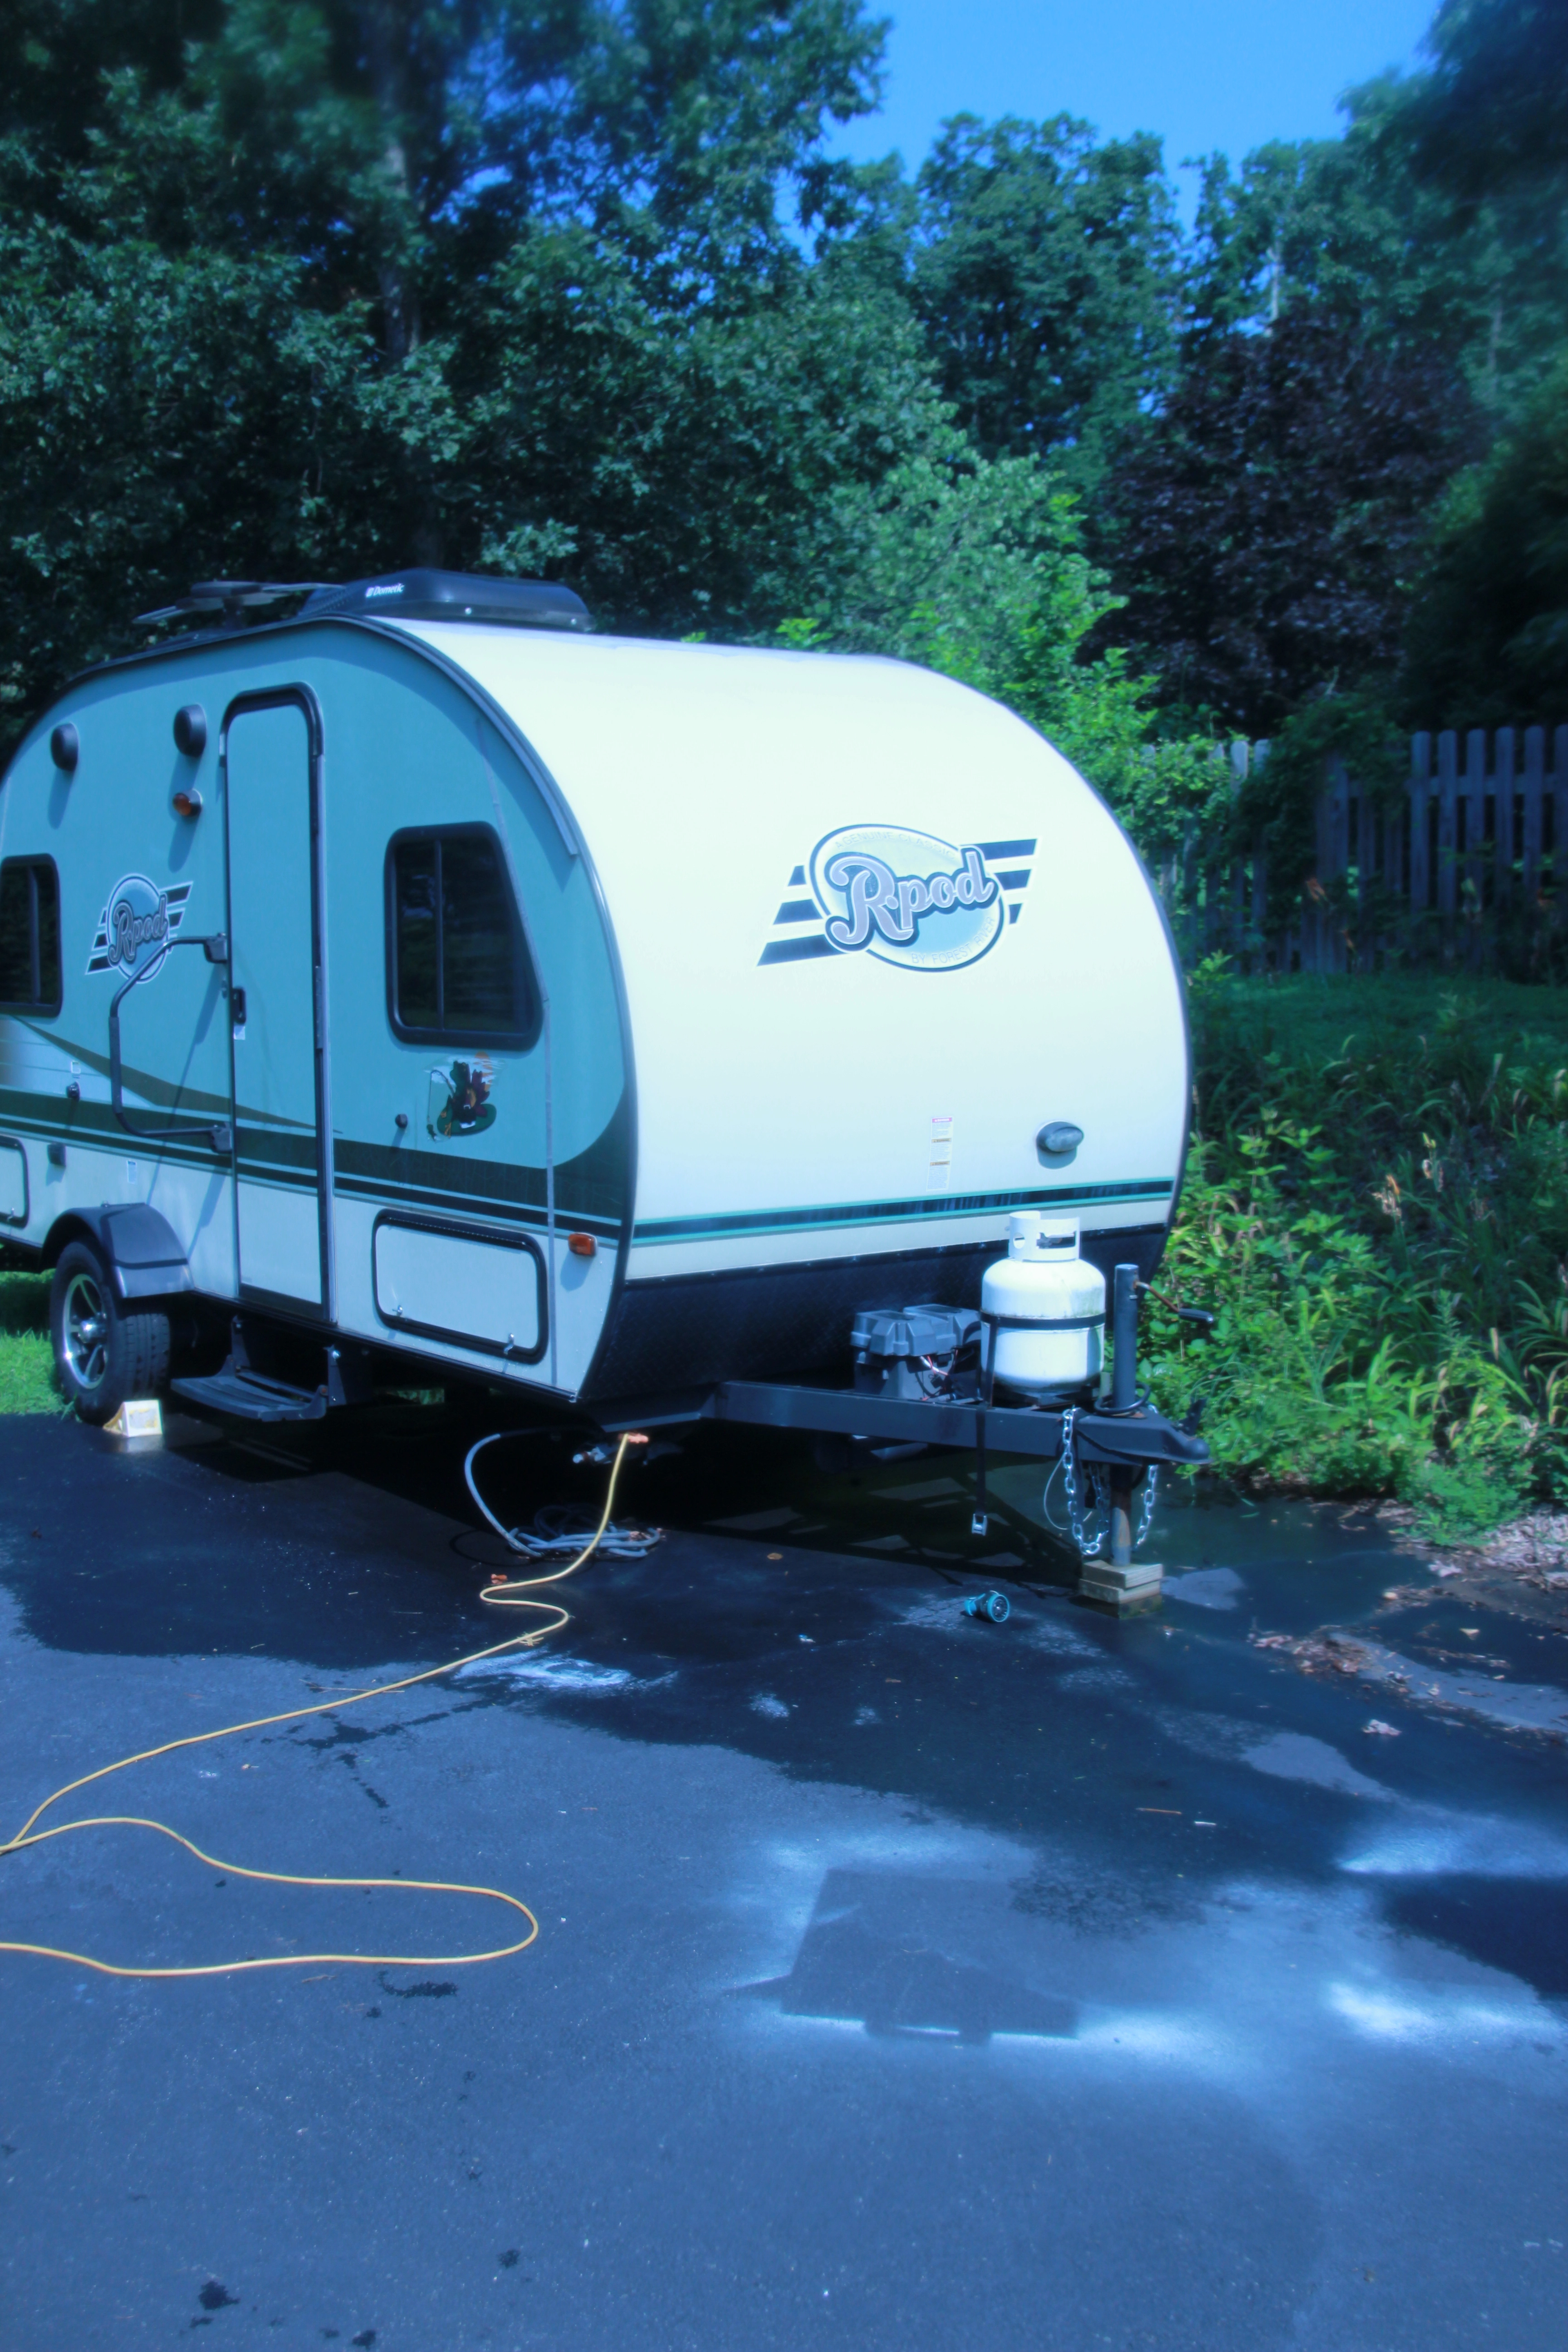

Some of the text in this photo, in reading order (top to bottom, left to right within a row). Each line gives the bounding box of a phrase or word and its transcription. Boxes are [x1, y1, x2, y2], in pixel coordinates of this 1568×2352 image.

[373, 583, 405, 596] Dometic
[835, 831, 955, 859] A GENUINE CLASSIC
[911, 916, 995, 964] BY FOREST RIVER
